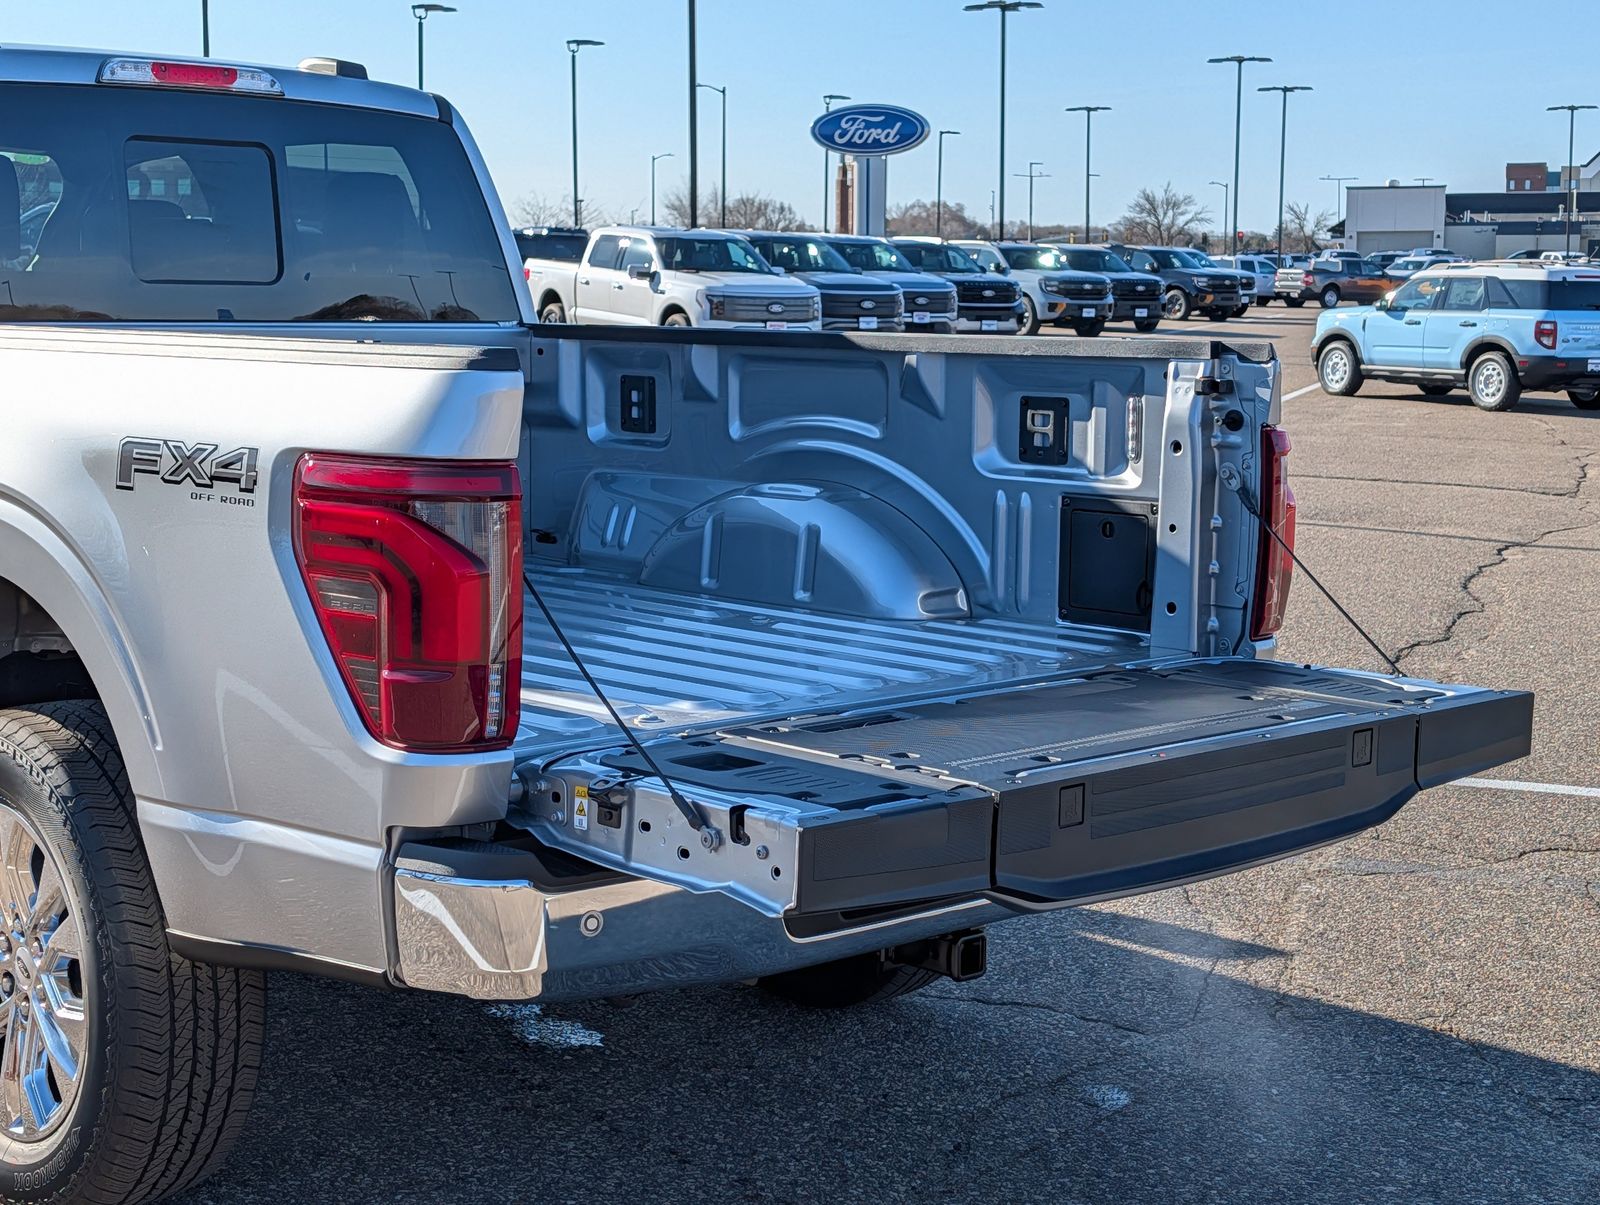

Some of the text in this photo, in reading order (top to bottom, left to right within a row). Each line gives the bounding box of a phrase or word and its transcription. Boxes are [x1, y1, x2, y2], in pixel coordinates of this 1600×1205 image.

[834, 115, 902, 144] Ford
[116, 436, 259, 493] FX4
[190, 491, 255, 507] OFF ROAD
